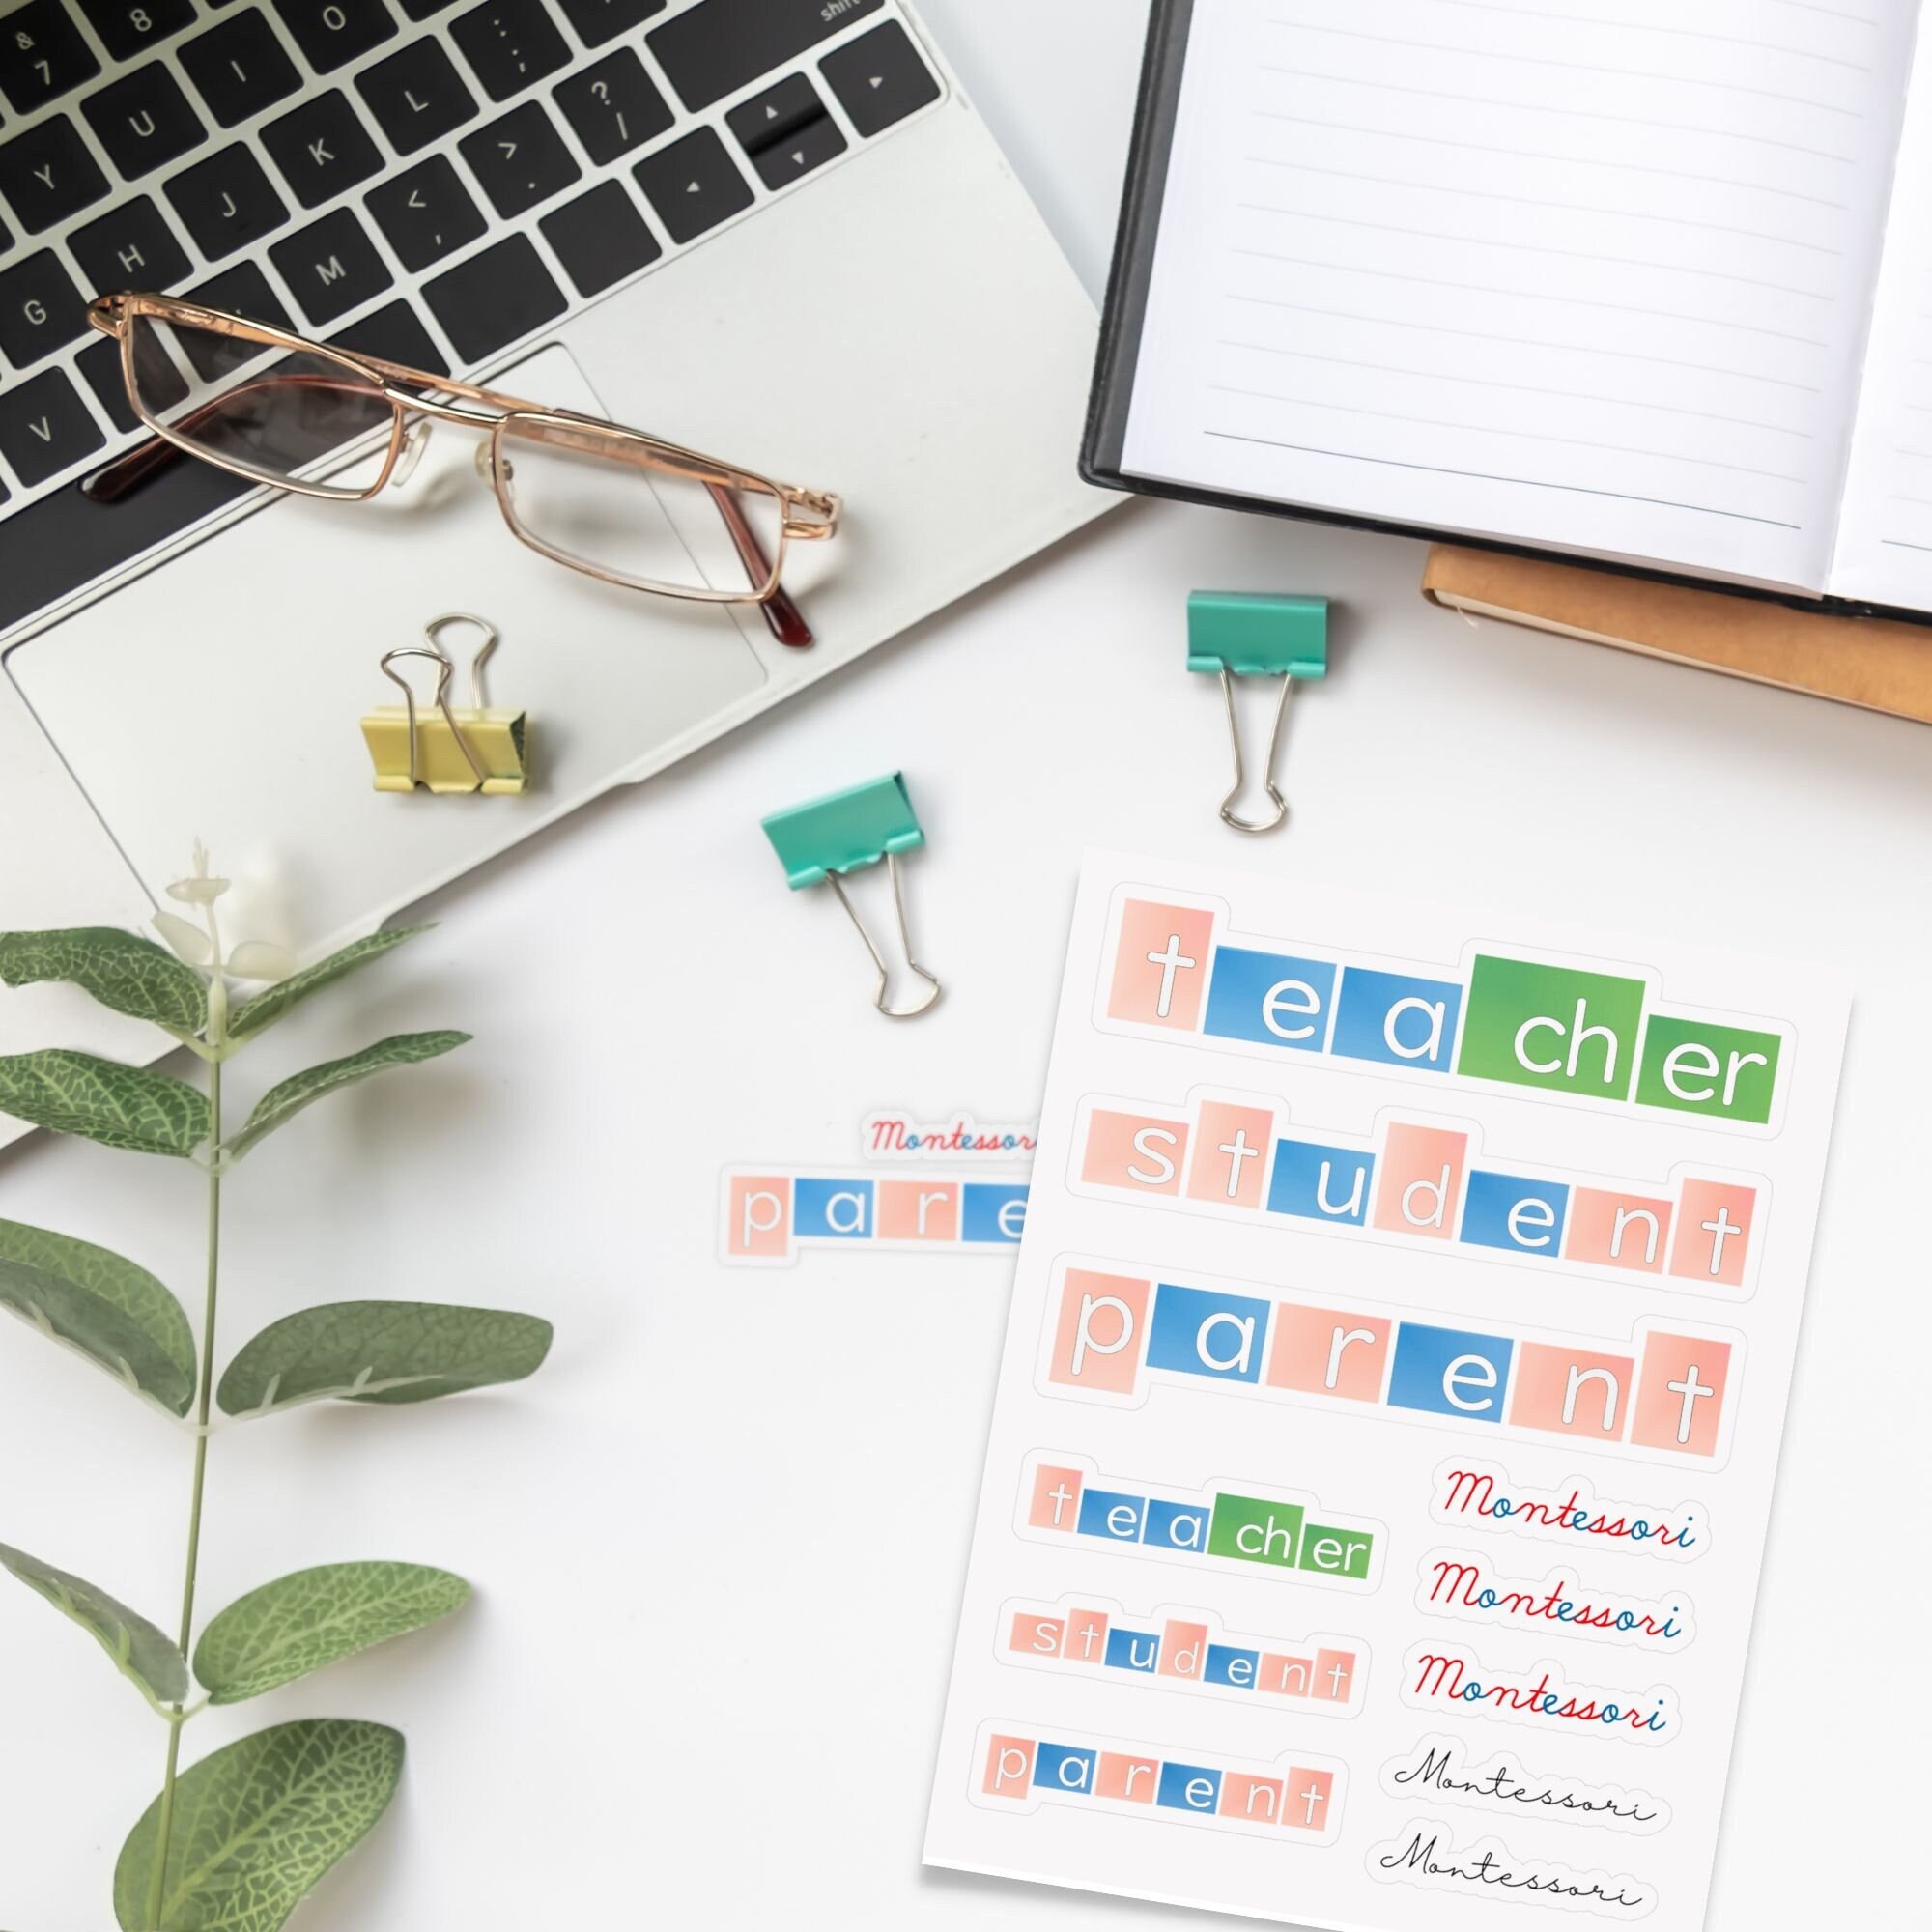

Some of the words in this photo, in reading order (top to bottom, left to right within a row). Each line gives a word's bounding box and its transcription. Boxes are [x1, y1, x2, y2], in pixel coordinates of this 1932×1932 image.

[129, 8, 153, 32] 8
[322, 5, 346, 31] O
[15, 31, 35, 50] &
[34, 59, 51, 86] 7
[404, 90, 429, 113] L
[591, 81, 611, 105] ?
[128, 110, 156, 137] U
[308, 138, 335, 166] K
[33, 164, 55, 189] Y
[222, 192, 237, 218] J
[117, 244, 145, 273] H
[315, 255, 346, 286] M
[23, 299, 47, 326] G
[28, 416, 51, 442] V
[1146, 932, 1769, 1107] teacher
[872, 1120, 1037, 1151] Montessor
[1125, 1122, 1743, 1276] student
[1069, 1292, 1716, 1445] parent
[1444, 1470, 1696, 1548] Montessori
[1046, 1483, 1368, 1572] teacher
[1430, 1561, 1682, 1639] Montessori
[1032, 1622, 1349, 1698] student
[1414, 1654, 1666, 1732] Montessori
[993, 1745, 1325, 1826] parent
[1394, 1747, 1657, 1821] Montessori
[1379, 1833, 1643, 1906] Montessori
